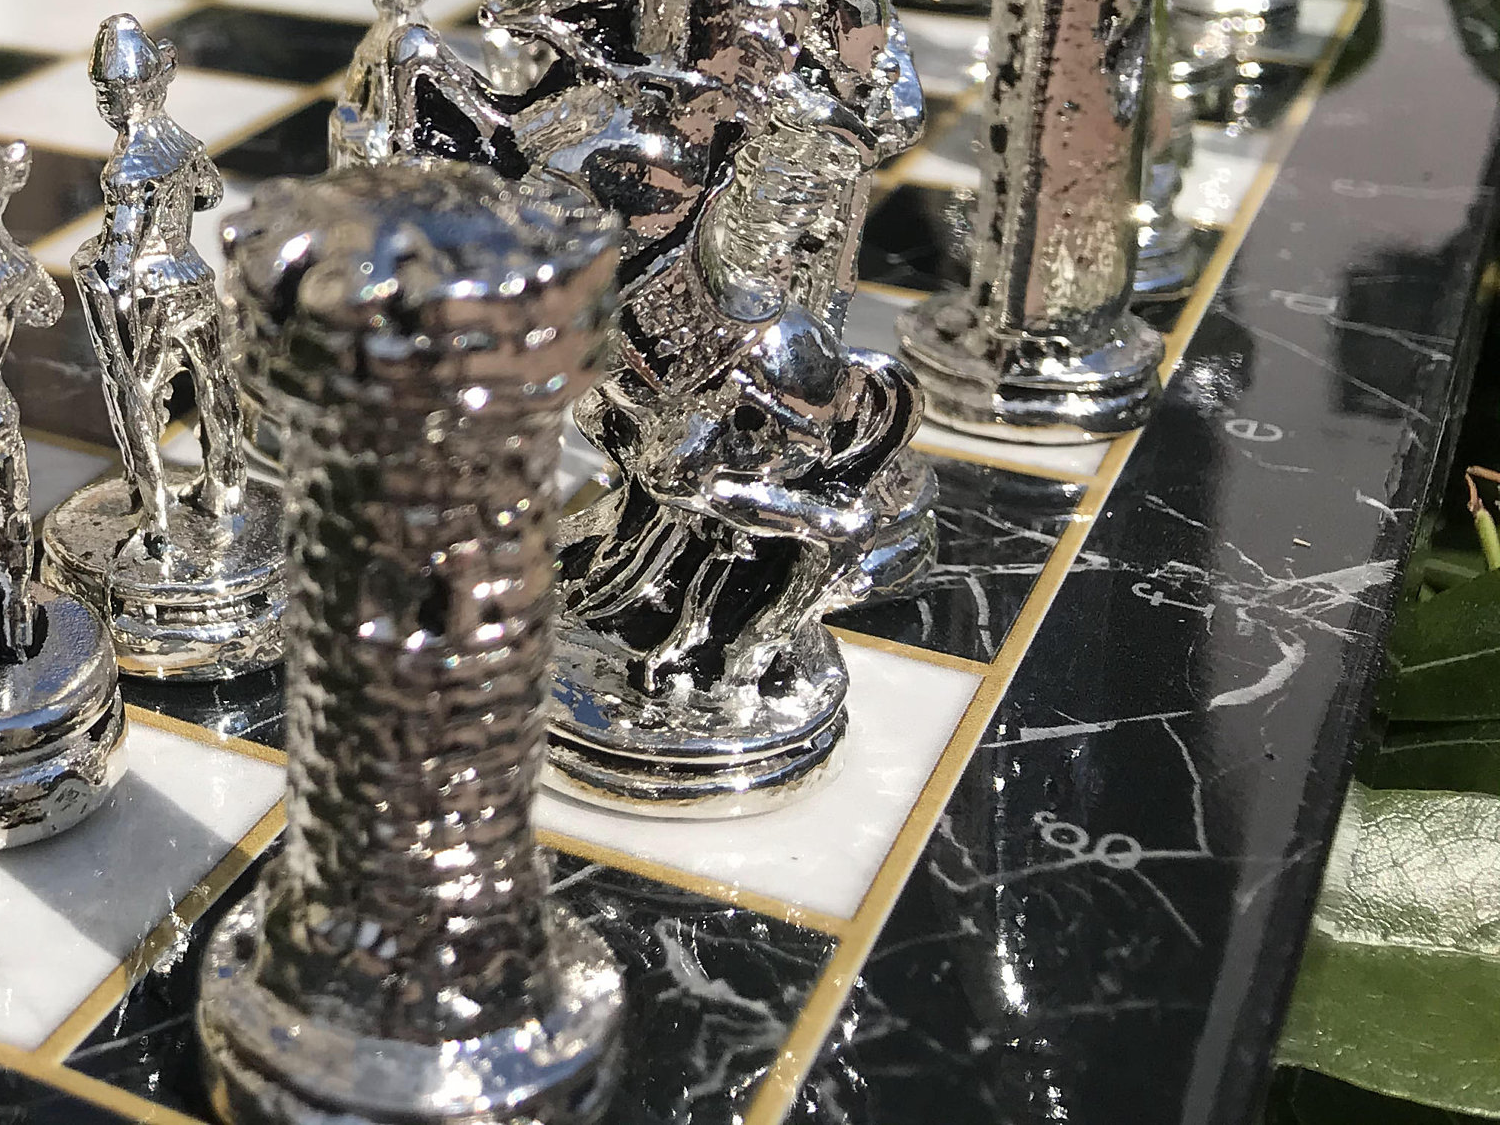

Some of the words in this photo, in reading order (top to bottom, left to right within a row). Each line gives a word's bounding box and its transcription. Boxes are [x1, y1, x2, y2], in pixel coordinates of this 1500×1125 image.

[1269, 289, 1340, 315] d
[1225, 418, 1283, 442] e
[1131, 582, 1216, 618] f
[1030, 810, 1142, 870] g
